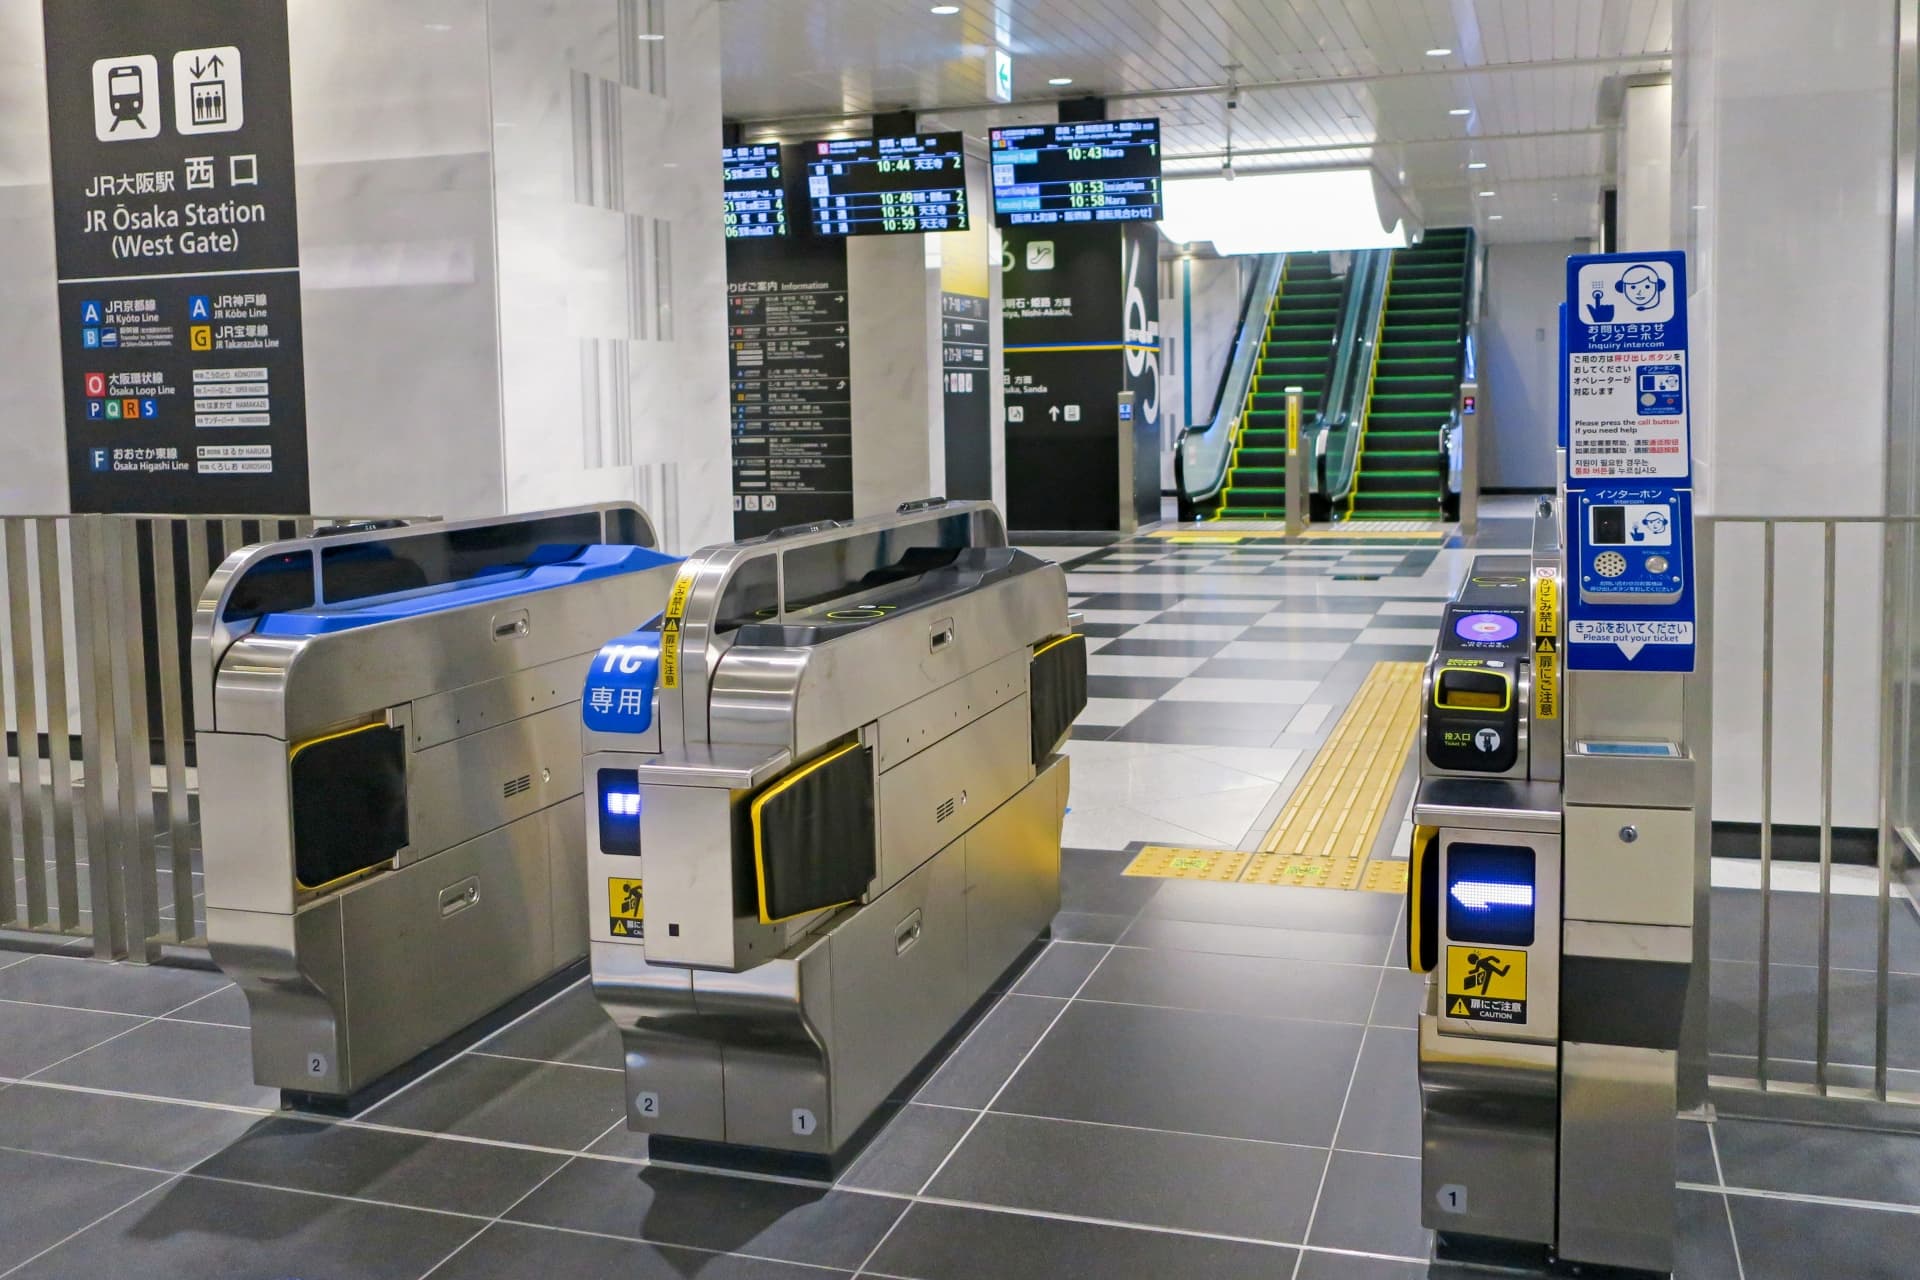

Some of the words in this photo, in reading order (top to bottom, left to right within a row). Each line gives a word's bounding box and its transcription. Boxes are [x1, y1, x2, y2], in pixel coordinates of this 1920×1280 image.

[1067, 147, 1102, 160] 10:43
[1150, 144, 1156, 156] 1
[877, 159, 911, 172] 10:44
[914, 159, 943, 170] 天王寺
[953, 156, 961, 168] 2
[86, 171, 175, 197] JR大阪駅
[185, 154, 258, 190] 西口
[772, 167, 780, 178] 6
[1069, 180, 1104, 194] 10:53
[1151, 179, 1157, 190] 1
[776, 199, 783, 209] 4
[880, 192, 913, 204] 10:49
[956, 190, 963, 201] 2
[1070, 195, 1104, 208] 10:58
[1152, 192, 1158, 204] 1
[84, 210, 108, 232] JR
[113, 204, 178, 230] Ōsaka
[185, 200, 264, 226] Station
[777, 212, 784, 222] 6
[881, 206, 915, 218] 10:54
[957, 204, 964, 214] 2
[778, 224, 786, 235] 4
[883, 219, 916, 231] 10:59
[958, 216, 965, 228] 2
[112, 234, 174, 258] (West
[180, 228, 238, 254] Gate)
[728, 282, 778, 292] りばご案内
[782, 282, 828, 290] Information
[85, 304, 98, 322] A
[193, 299, 207, 317] A
[249, 308, 267, 317] Line
[1124, 239, 1147, 377] 6
[106, 314, 114, 324] JR
[142, 313, 159, 322] Line
[1588, 324, 1664, 334] お問い合わせ
[88, 331, 95, 344] B
[195, 330, 206, 346] G
[264, 339, 279, 348] Line
[1588, 333, 1664, 342] インターホン
[1588, 342, 1620, 350] Inquiry
[1574, 365, 1631, 374] おしてください
[89, 376, 102, 394] O
[1574, 376, 1631, 384] オペレーターが
[136, 386, 156, 397] Loop
[158, 386, 175, 394] Line
[1574, 388, 1614, 396] 対応します
[91, 402, 100, 416] P
[107, 402, 118, 416] Q
[127, 402, 135, 415] R
[145, 401, 153, 416] S
[95, 451, 104, 468] F
[140, 461, 169, 472] Higashi
[171, 461, 189, 470] Line
[1596, 490, 1662, 499] インターホン
[1539, 578, 1553, 633] かけこみ禁止
[1576, 622, 1687, 634] きっぷをおいてください
[1613, 634, 1628, 642] put
[1654, 634, 1679, 642] ticket
[1539, 656, 1553, 716] 扉にご注意
[589, 686, 642, 715] 専用
[1470, 998, 1522, 1012] 扉にご注意
[1480, 1010, 1512, 1019] CAUTION
[312, 1058, 320, 1072] 2
[644, 1098, 653, 1111] 2
[798, 1115, 804, 1129] 1
[1448, 1191, 1456, 1207] 1
